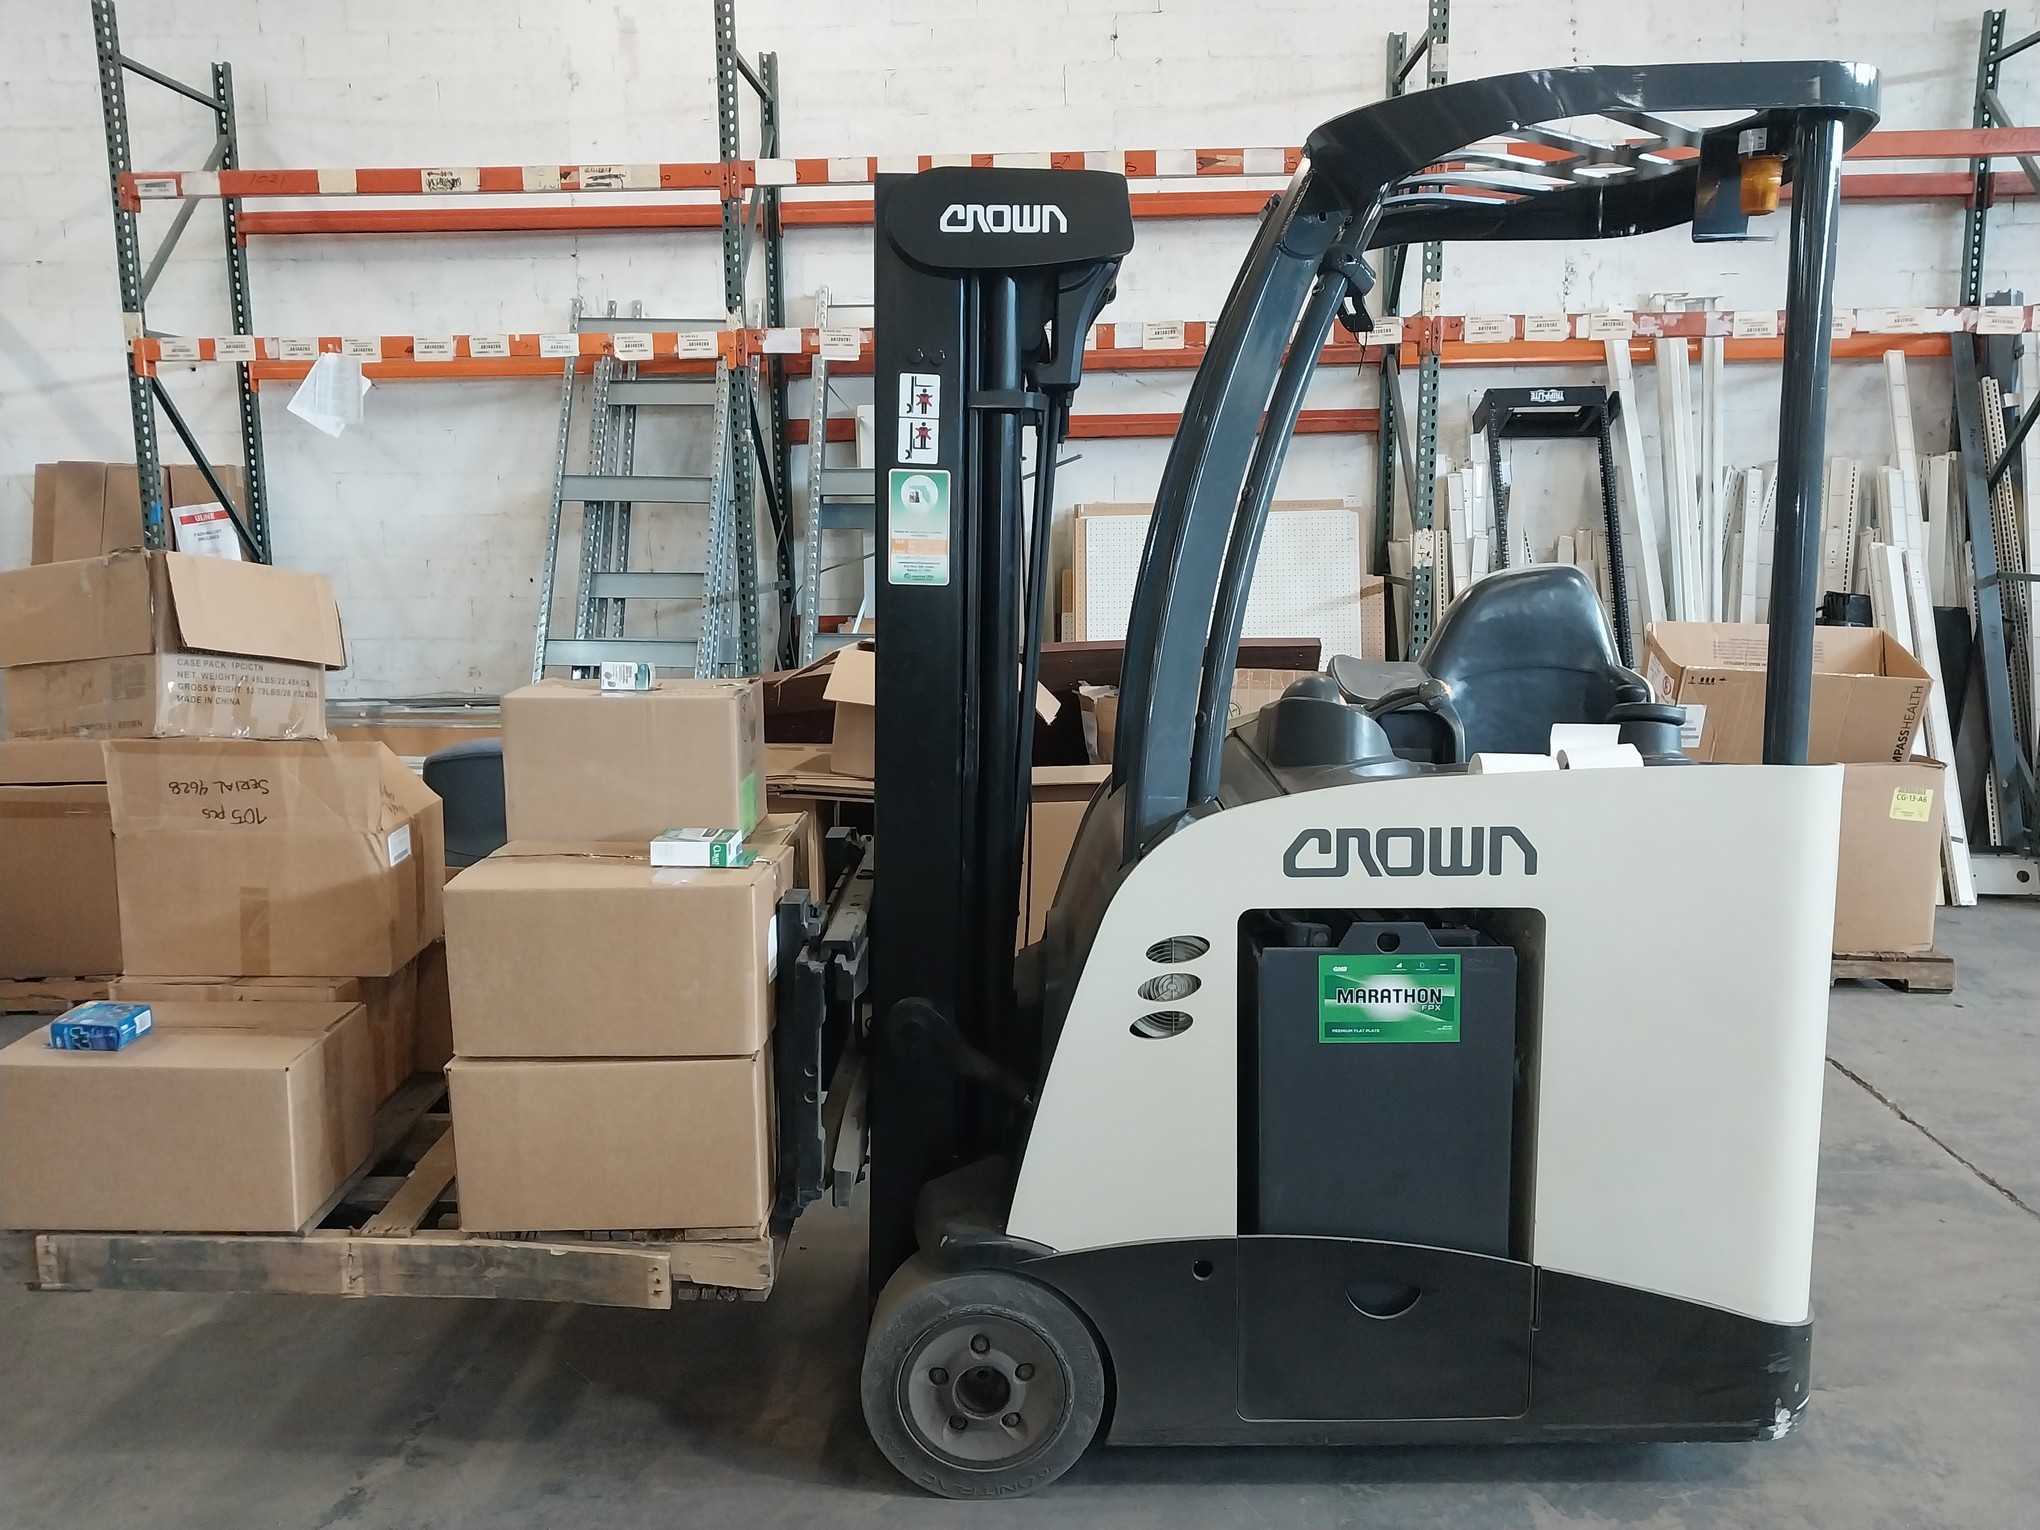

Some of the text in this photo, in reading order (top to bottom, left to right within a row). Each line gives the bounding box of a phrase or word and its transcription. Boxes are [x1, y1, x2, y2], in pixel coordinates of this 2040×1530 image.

[939, 204, 1068, 234] CROWN
[177, 658, 201, 667] CASE
[177, 671, 196, 679] NET
[177, 682, 208, 692] GROSS
[177, 695, 241, 706] MADE IN CHINA
[168, 780, 209, 796] 4628
[1282, 825, 1539, 878] CROWN
[1336, 987, 1443, 1006] MARATHON
[1421, 1004, 1442, 1012] FPX
